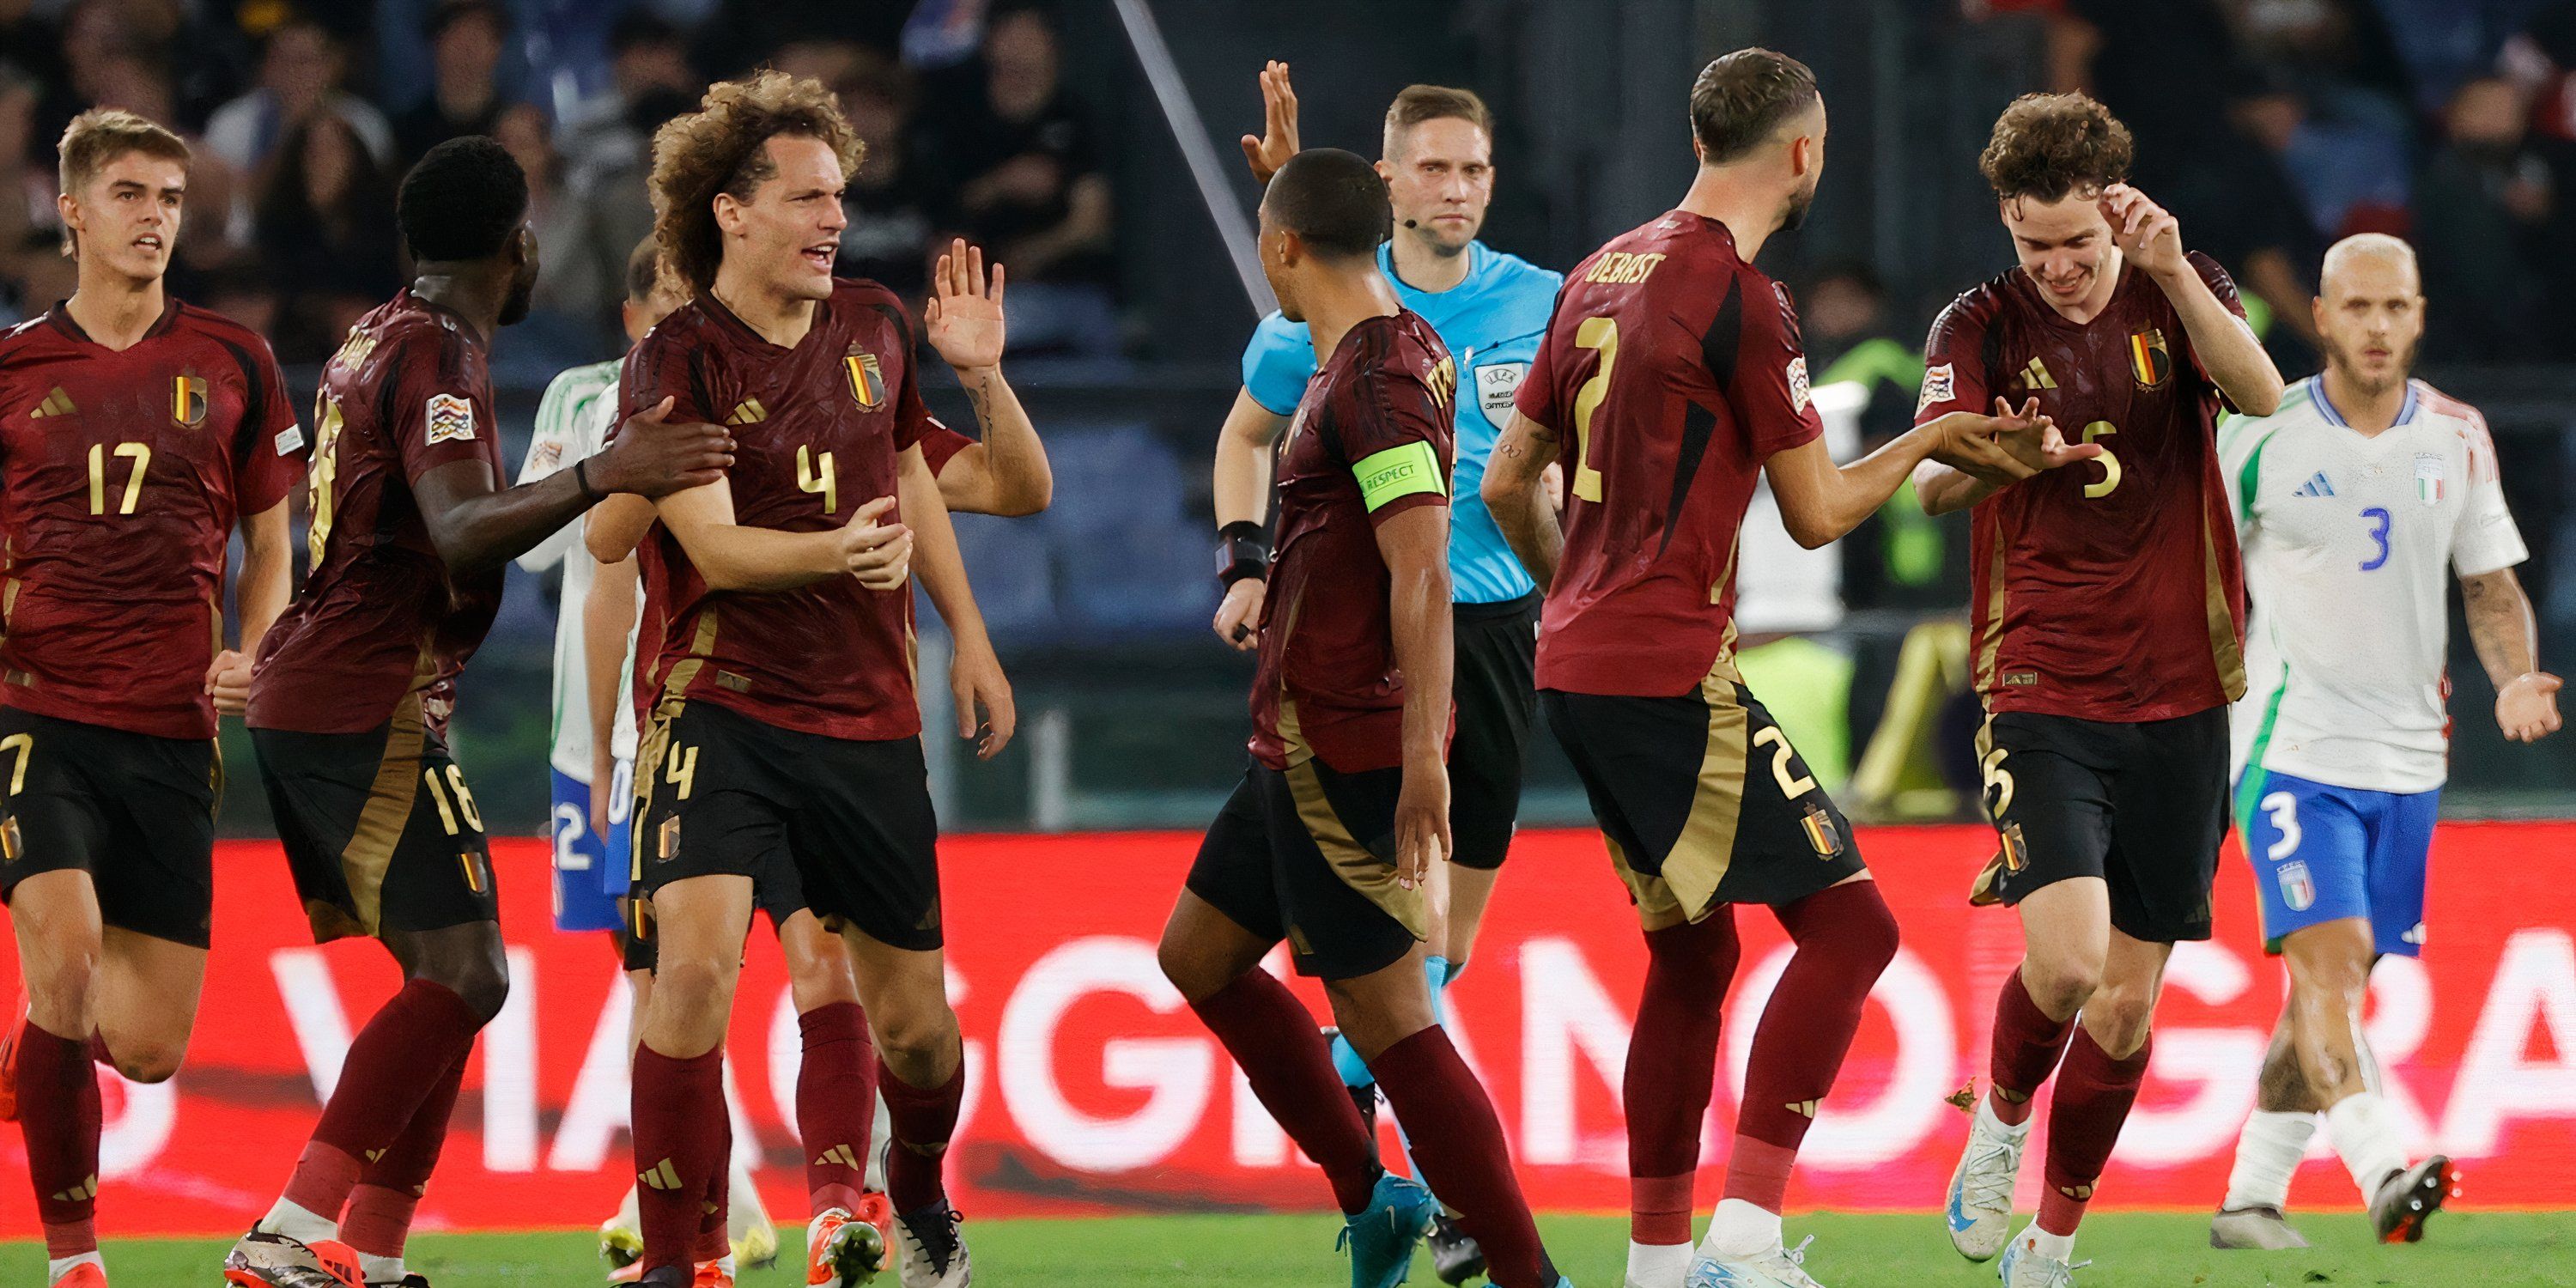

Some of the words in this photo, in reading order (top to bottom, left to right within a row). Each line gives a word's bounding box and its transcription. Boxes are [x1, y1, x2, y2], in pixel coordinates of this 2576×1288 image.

[1584, 252, 1668, 283] DEBAST
[1573, 318, 1618, 503] 2
[88, 442, 150, 515] 17
[796, 445, 836, 514] 4
[1367, 464, 1415, 490] RESPECT
[2083, 421, 2121, 498] 5
[2358, 507, 2391, 572] 3
[665, 740, 699, 800] 4
[1753, 726, 1815, 799] 2
[1983, 749, 2014, 819] 5
[424, 763, 485, 836] 18
[2261, 791, 2302, 860] 3
[268, 934, 1957, 1175] IAGNO
